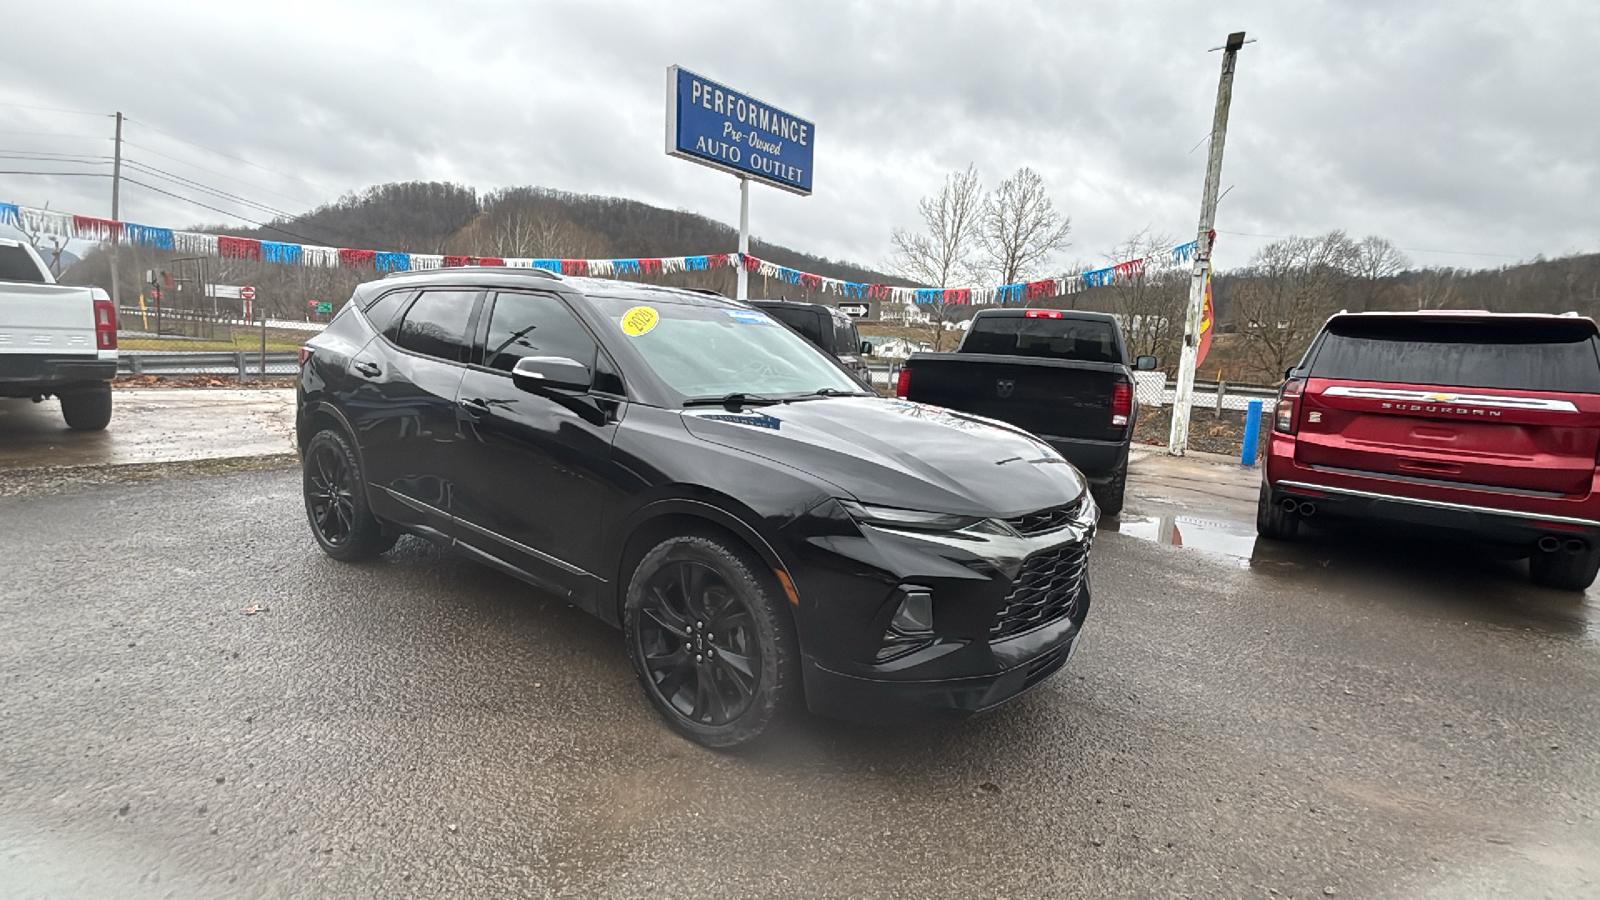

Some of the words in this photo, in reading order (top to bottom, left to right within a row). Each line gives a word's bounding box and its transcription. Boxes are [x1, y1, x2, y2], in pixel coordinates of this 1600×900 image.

[692, 79, 807, 146] PERFORMANCE
[722, 121, 782, 156] Pre-Owned
[696, 136, 741, 163] AUTO
[750, 153, 803, 183] OUTLET
[628, 308, 654, 333] 2020
[1381, 402, 1501, 417] SUBURBAN
